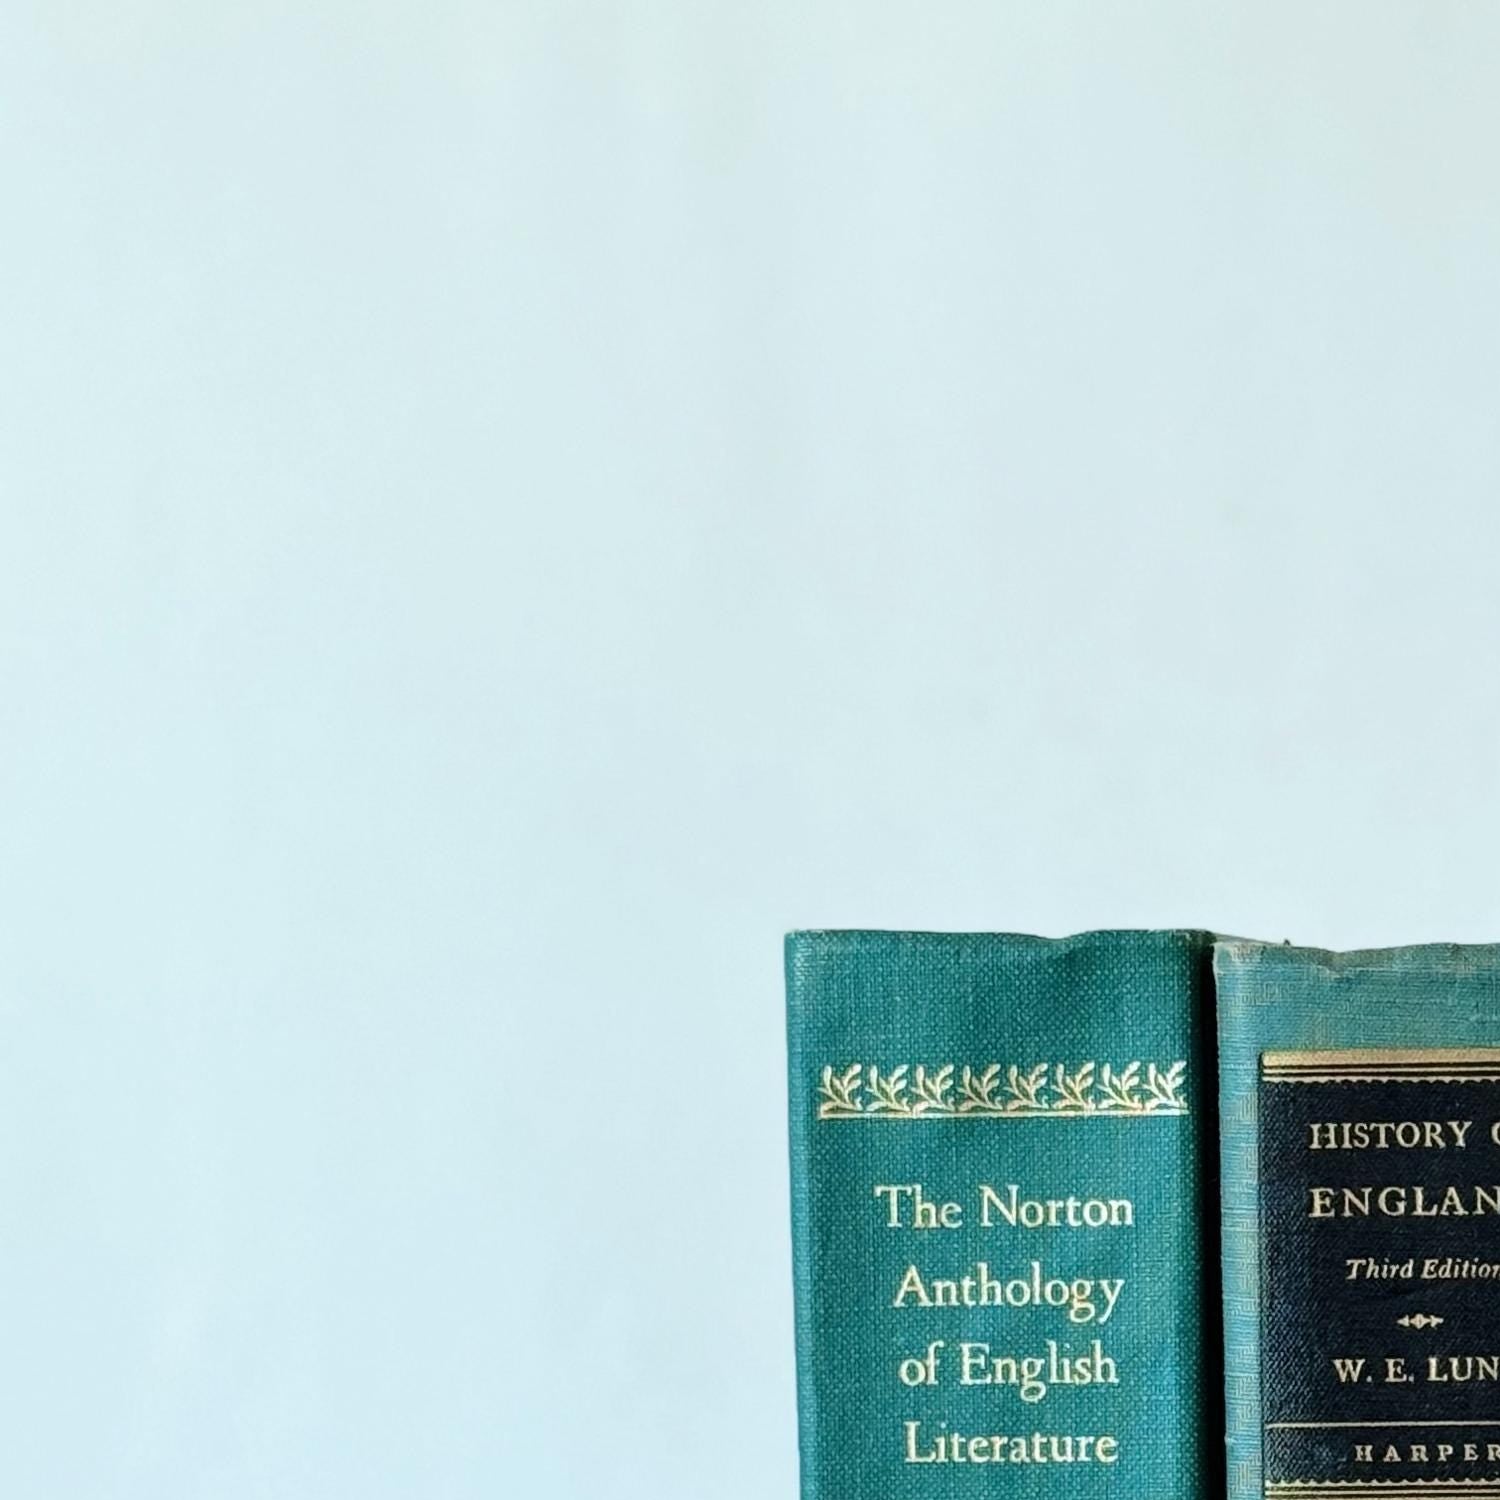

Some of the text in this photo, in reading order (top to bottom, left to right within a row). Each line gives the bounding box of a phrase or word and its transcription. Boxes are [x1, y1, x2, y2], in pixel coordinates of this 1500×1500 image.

[1309, 1121, 1472, 1150] HISTORY
[874, 1184, 1134, 1229] The Norton
[1345, 1257, 1414, 1280] Third
[893, 1261, 1125, 1325] Anthology
[898, 1340, 1120, 1403] of English
[1332, 1358, 1373, 1383] W.
[1384, 1358, 1415, 1383] E.
[904, 1420, 1119, 1464] Literature
